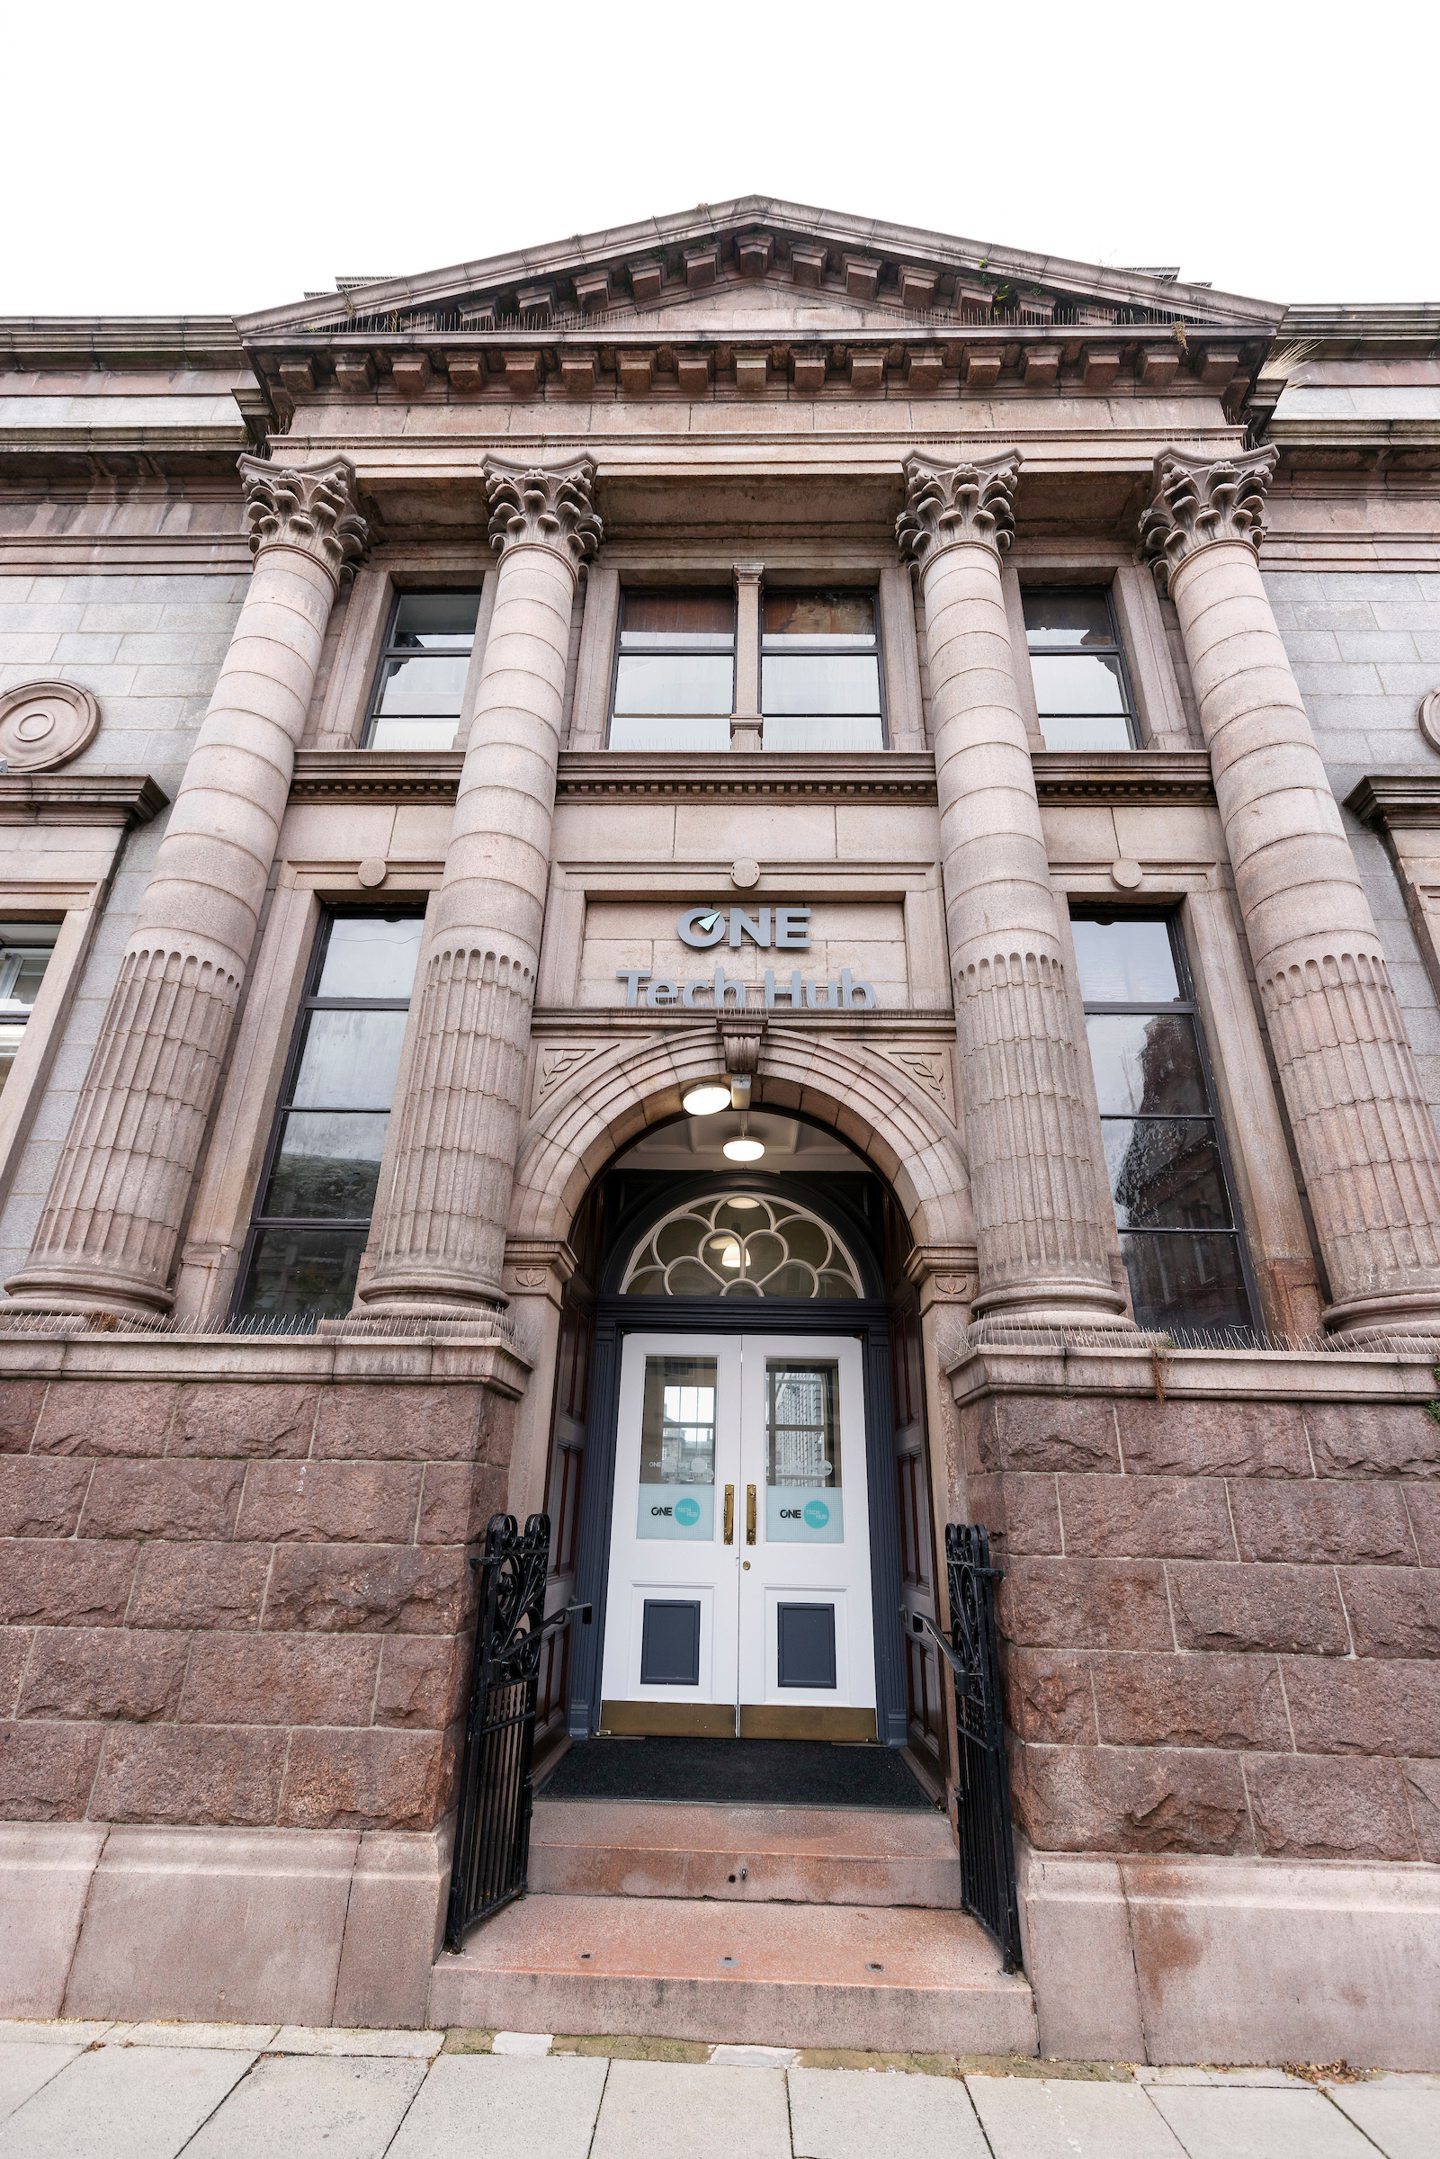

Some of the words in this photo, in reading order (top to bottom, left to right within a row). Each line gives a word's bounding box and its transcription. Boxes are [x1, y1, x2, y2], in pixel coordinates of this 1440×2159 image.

[677, 907, 812, 948] ONE
[616, 967, 745, 1008] Tech
[765, 967, 876, 1009] Hub
[651, 1506, 673, 1517] ONE
[780, 1509, 802, 1519] ONE
